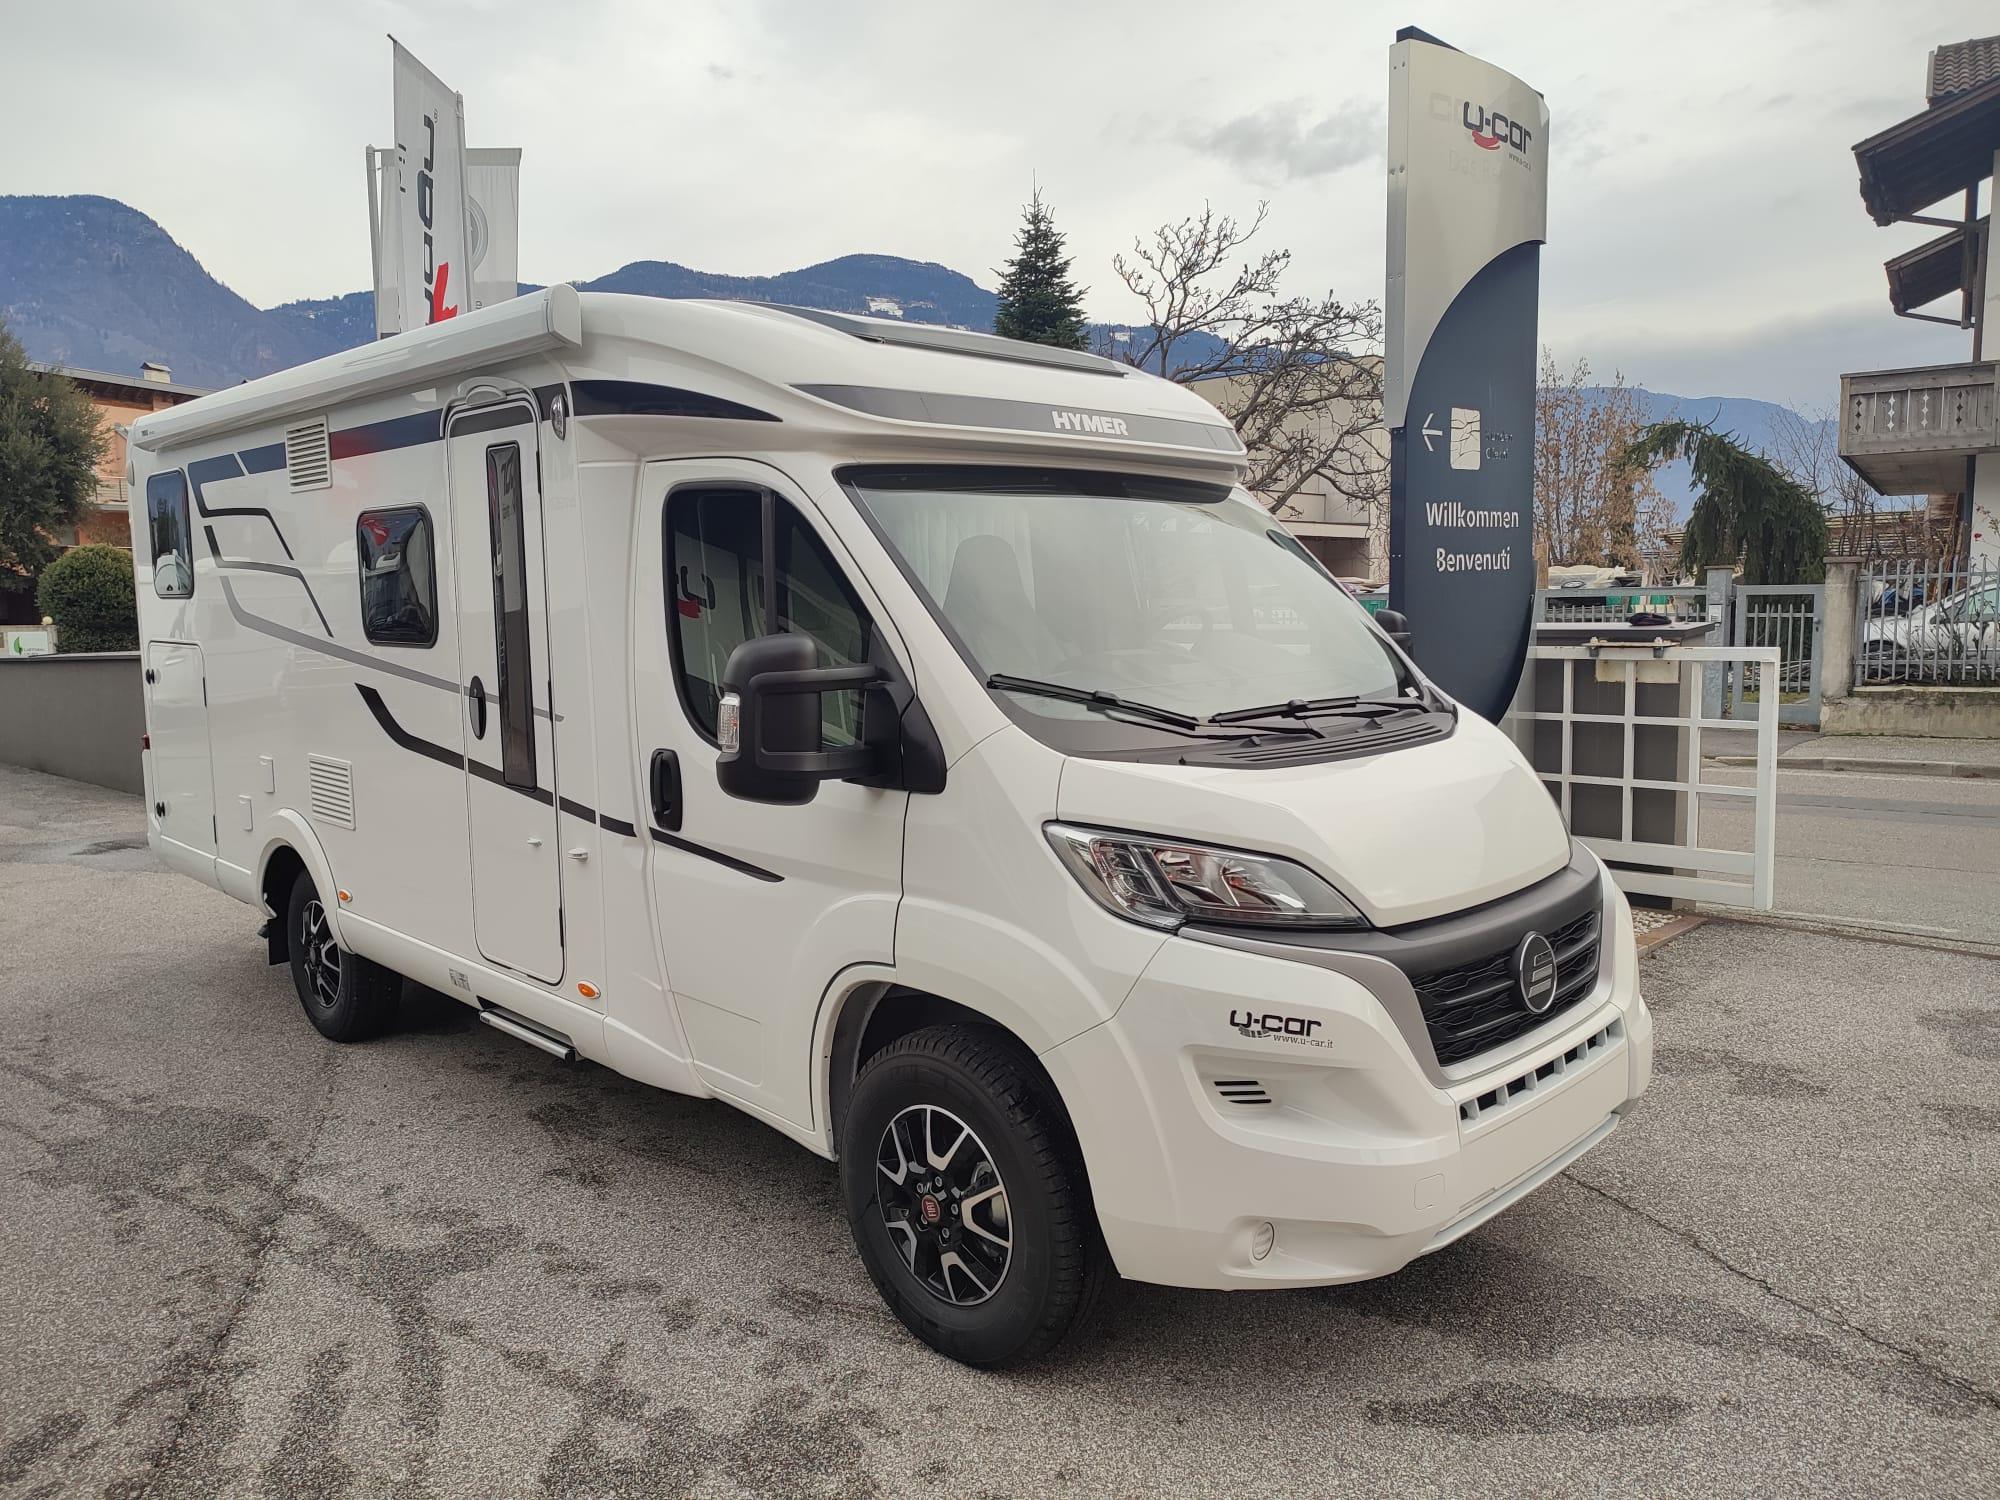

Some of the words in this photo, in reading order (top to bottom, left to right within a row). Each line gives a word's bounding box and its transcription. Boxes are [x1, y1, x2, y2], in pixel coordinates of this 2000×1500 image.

[1463, 101, 1532, 155] u-car
[1051, 410, 1129, 436] HYMER
[1425, 502, 1520, 529] Willkommen
[1436, 546, 1511, 572] Benvenuti
[1229, 1009, 1322, 1037] u-car
[1273, 1034, 1334, 1049] www.u-car.it
[925, 1200, 938, 1217] FIAT
